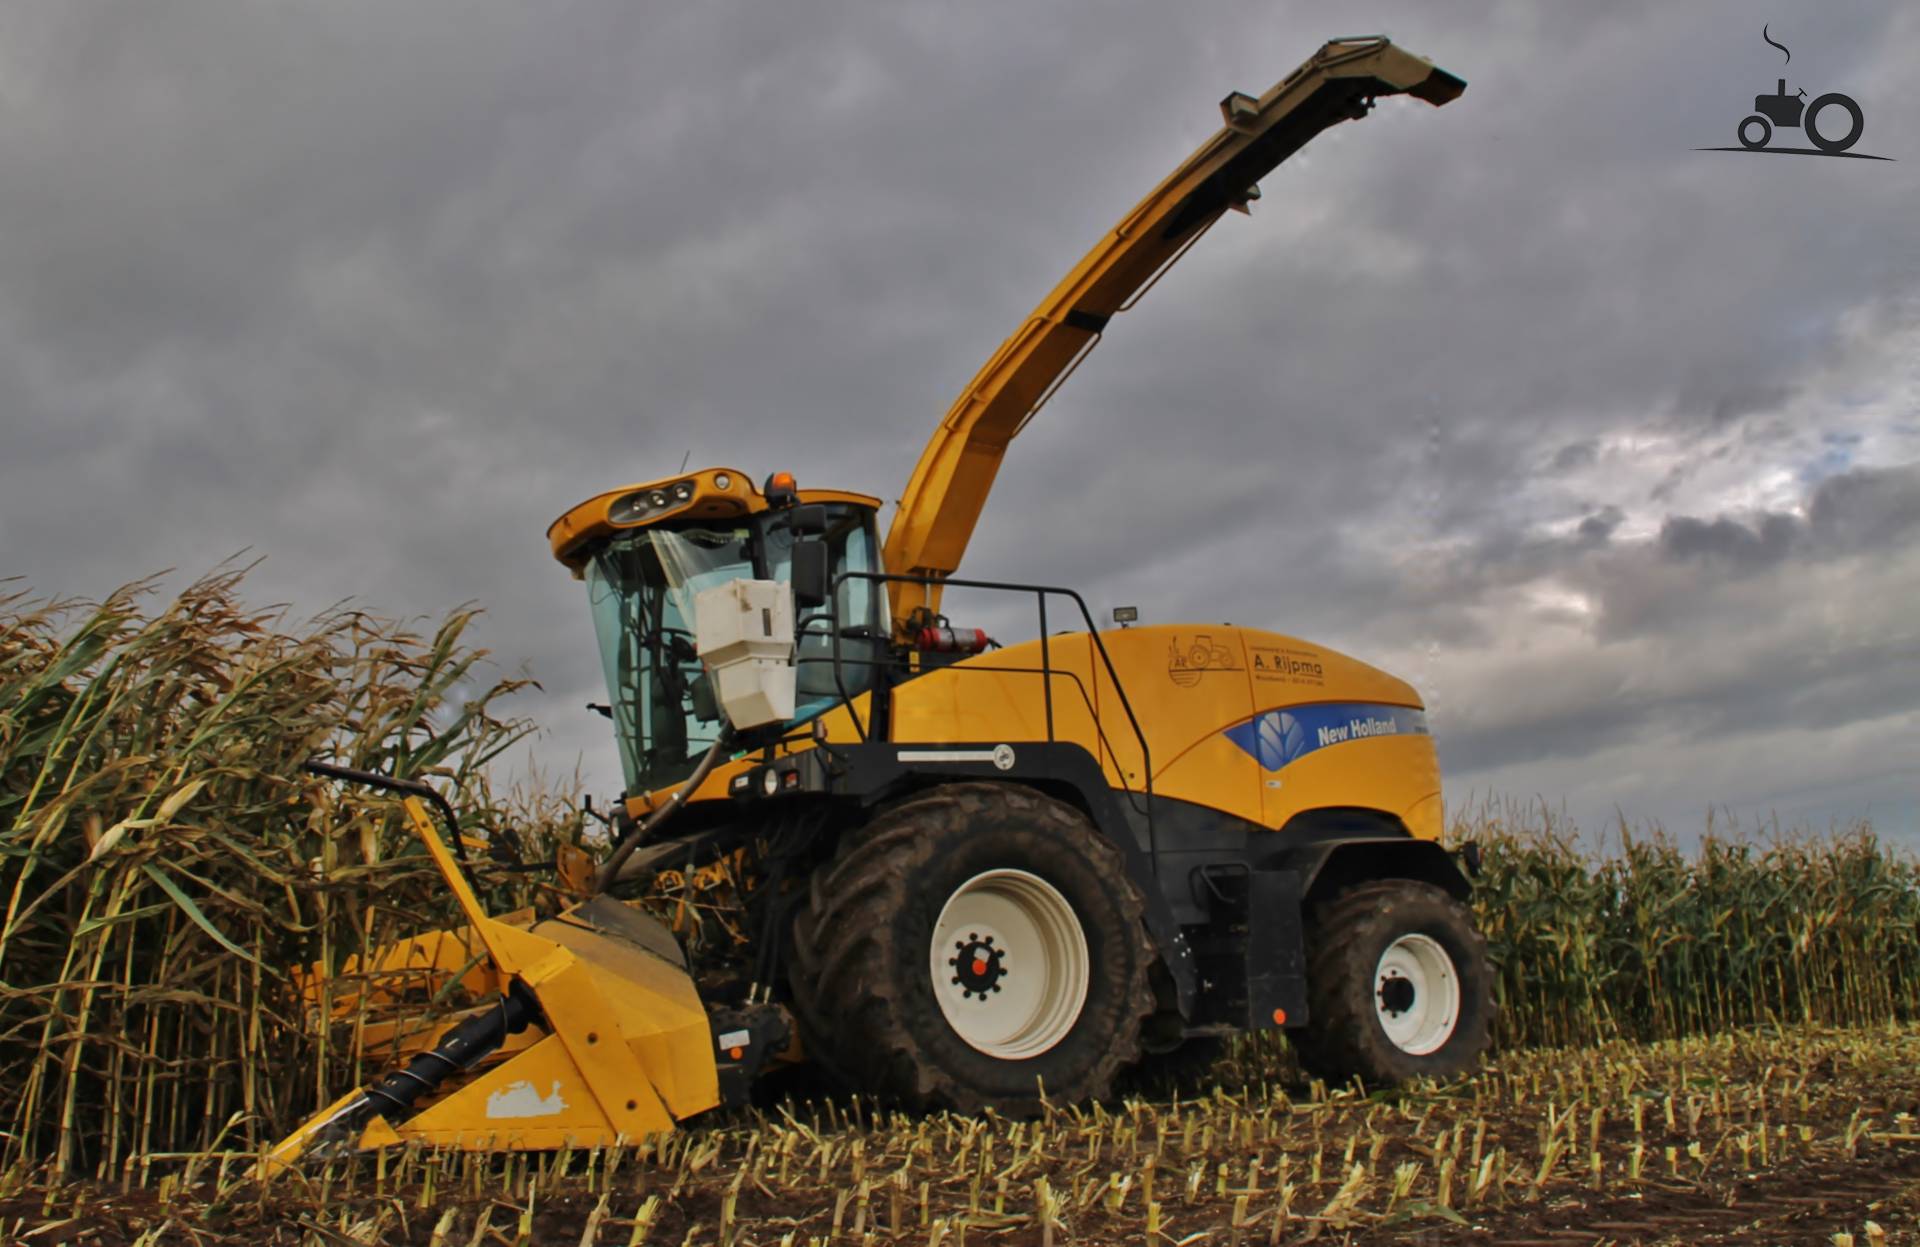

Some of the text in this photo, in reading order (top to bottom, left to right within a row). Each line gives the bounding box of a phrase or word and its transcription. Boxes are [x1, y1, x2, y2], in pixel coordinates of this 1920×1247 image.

[1254, 654, 1323, 675] A. Rijpma
[1318, 726, 1348, 747] New
[1350, 717, 1397, 738] Holland
